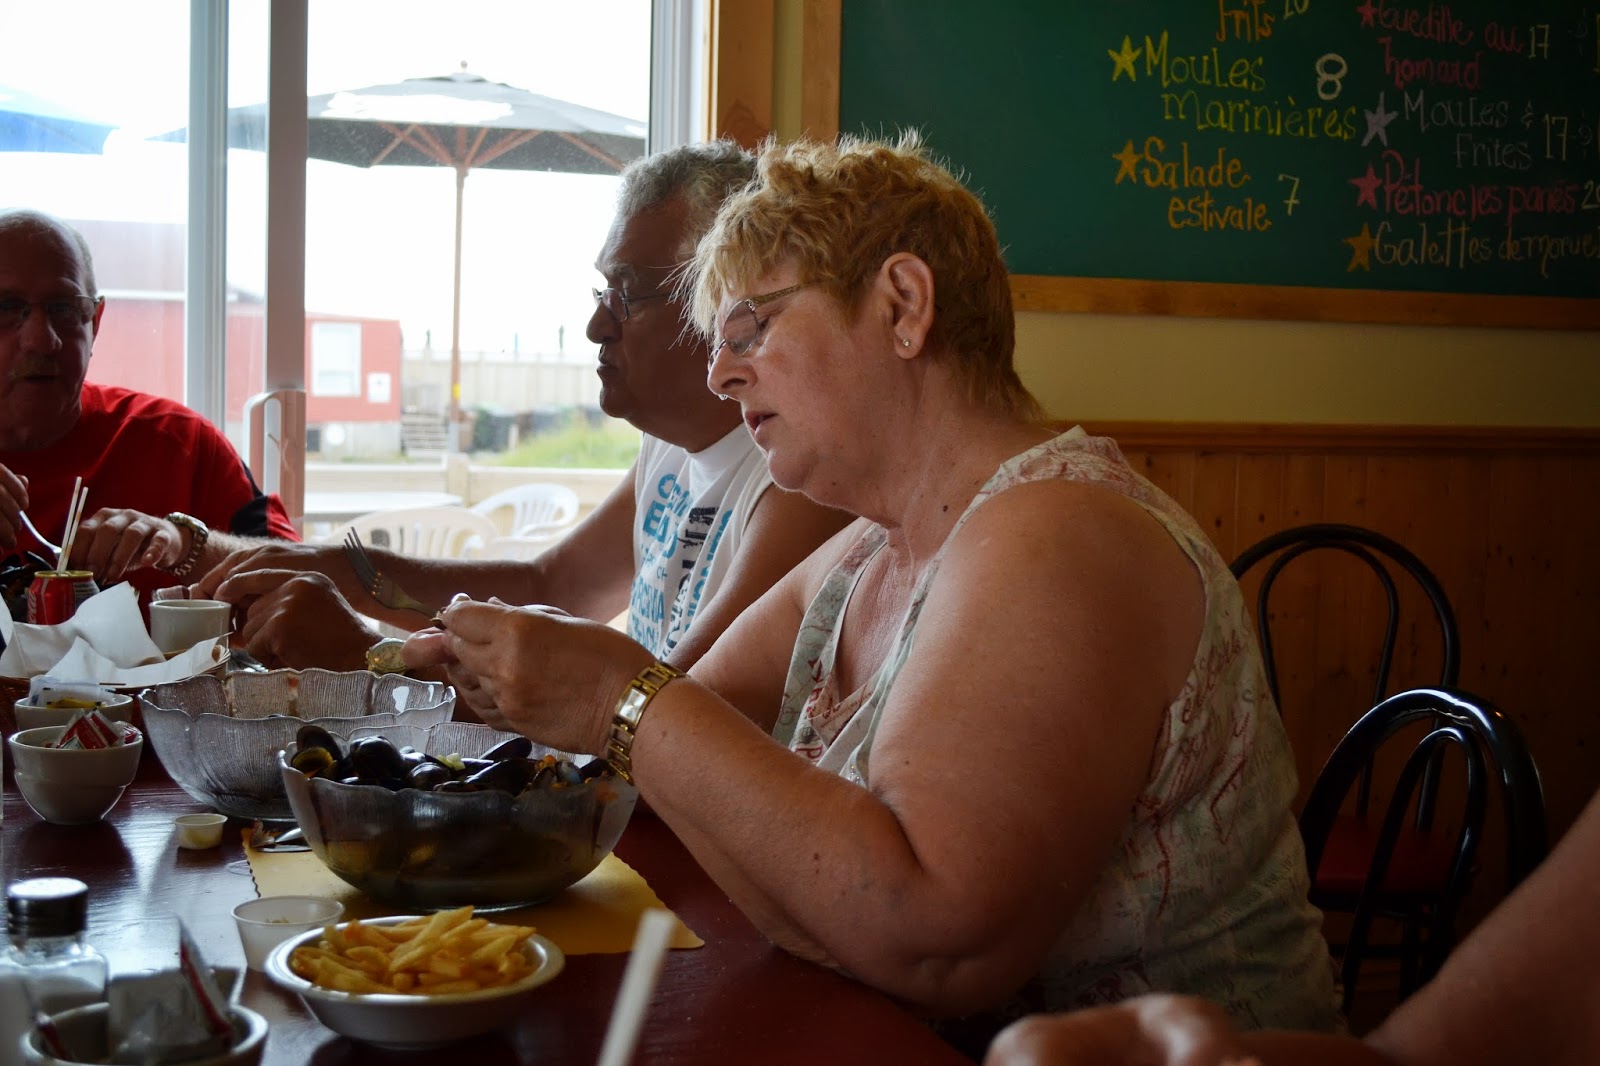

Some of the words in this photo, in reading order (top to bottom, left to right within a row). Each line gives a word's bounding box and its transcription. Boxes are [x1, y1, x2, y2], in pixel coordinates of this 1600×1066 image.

[1145, 29, 1266, 92] Moules
[1315, 53, 1348, 100] 8
[1529, 24, 1550, 60] 17
[1404, 89, 1510, 133] Moules
[1543, 113, 1568, 161] 17
[1454, 133, 1532, 170] Frites
[1141, 136, 1251, 189] Salade
[1168, 190, 1273, 232] estivale
[1277, 174, 1300, 216] 7
[1375, 218, 1493, 269] Galettes
